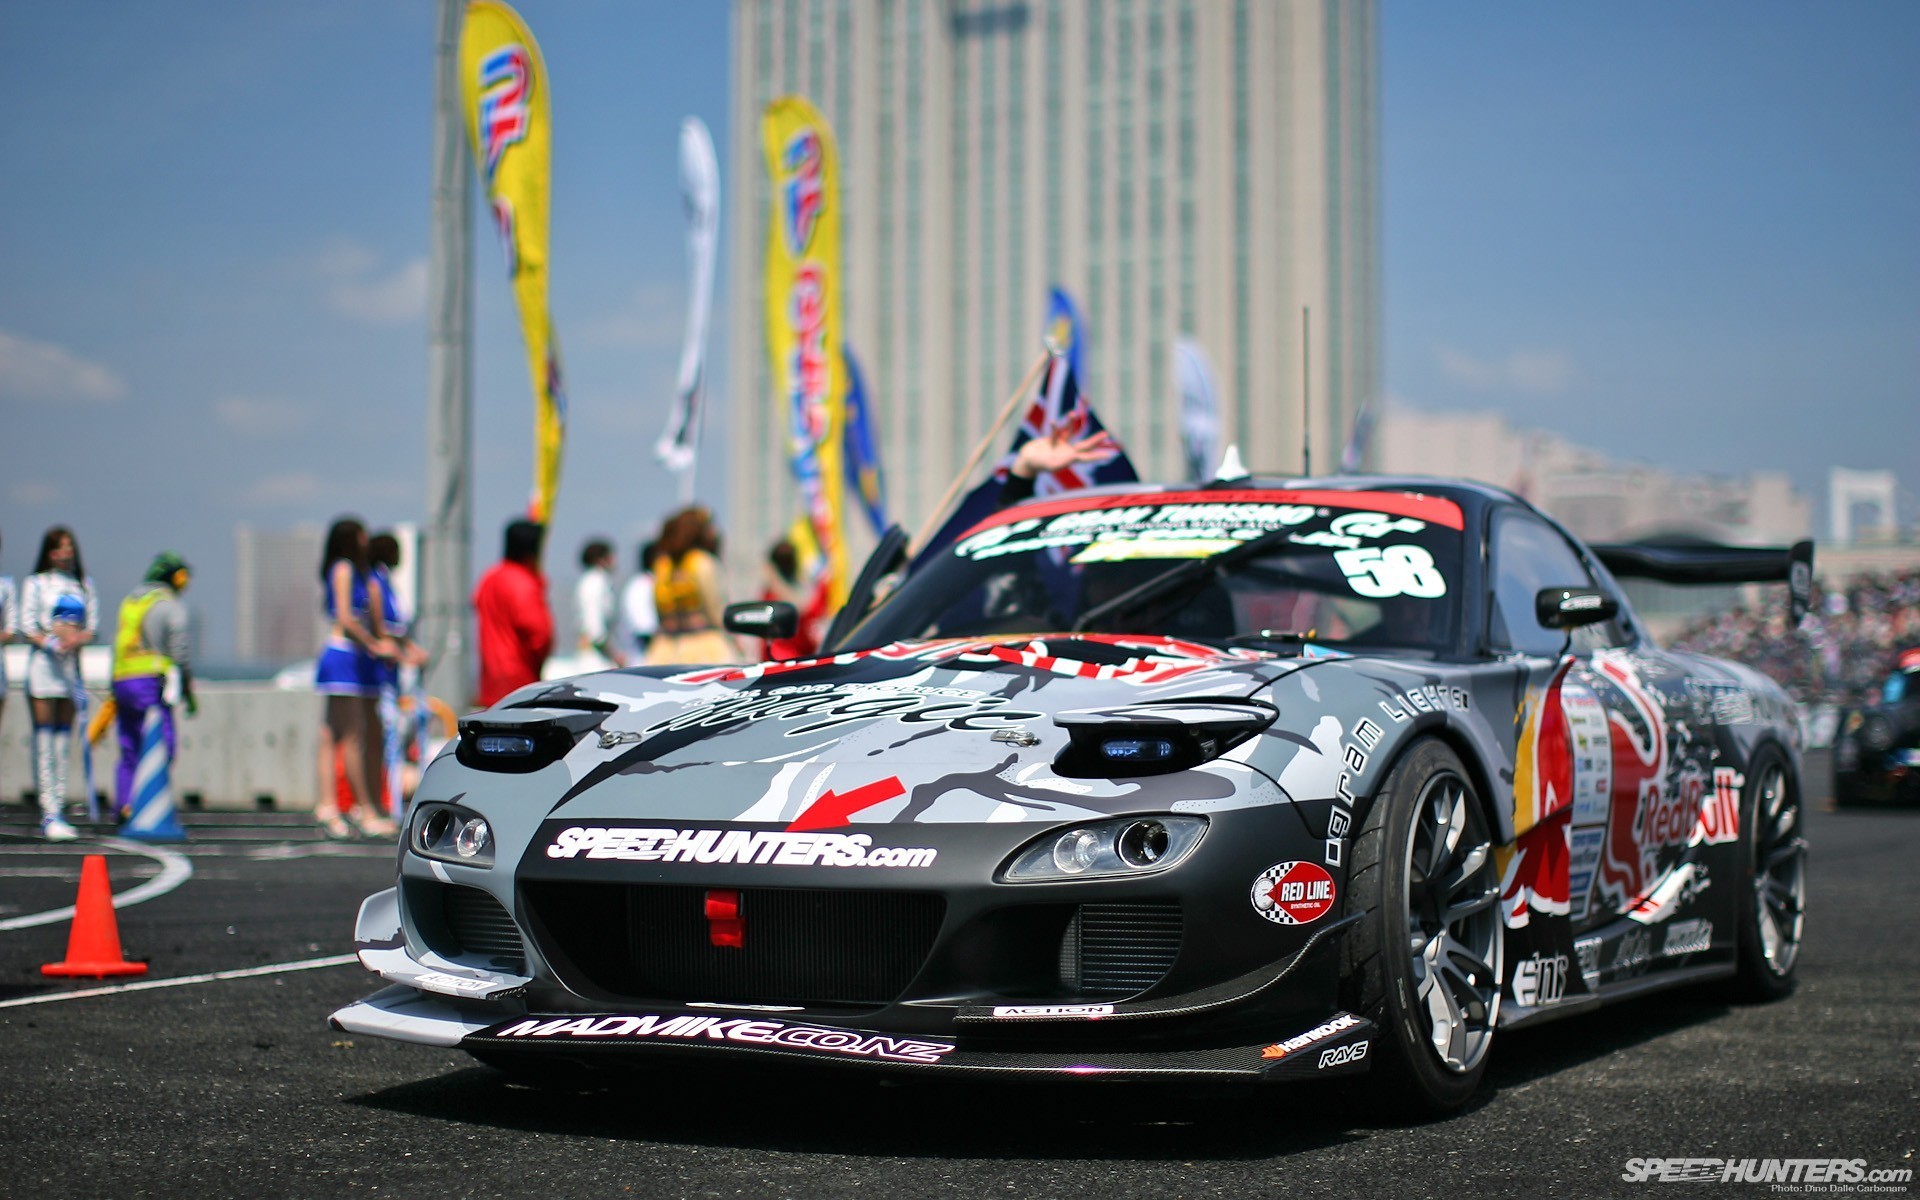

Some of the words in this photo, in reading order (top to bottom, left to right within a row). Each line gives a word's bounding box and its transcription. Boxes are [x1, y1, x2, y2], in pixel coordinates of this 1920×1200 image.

[1333, 544, 1447, 598] 58
[548, 827, 937, 868] SPEEDHUNTERS.com
[1281, 882, 1304, 901] RED
[1004, 1007, 1104, 1015] ACTION
[497, 1016, 956, 1063] MADMIKE.CO.NZ
[1318, 1040, 1369, 1069] RAYS
